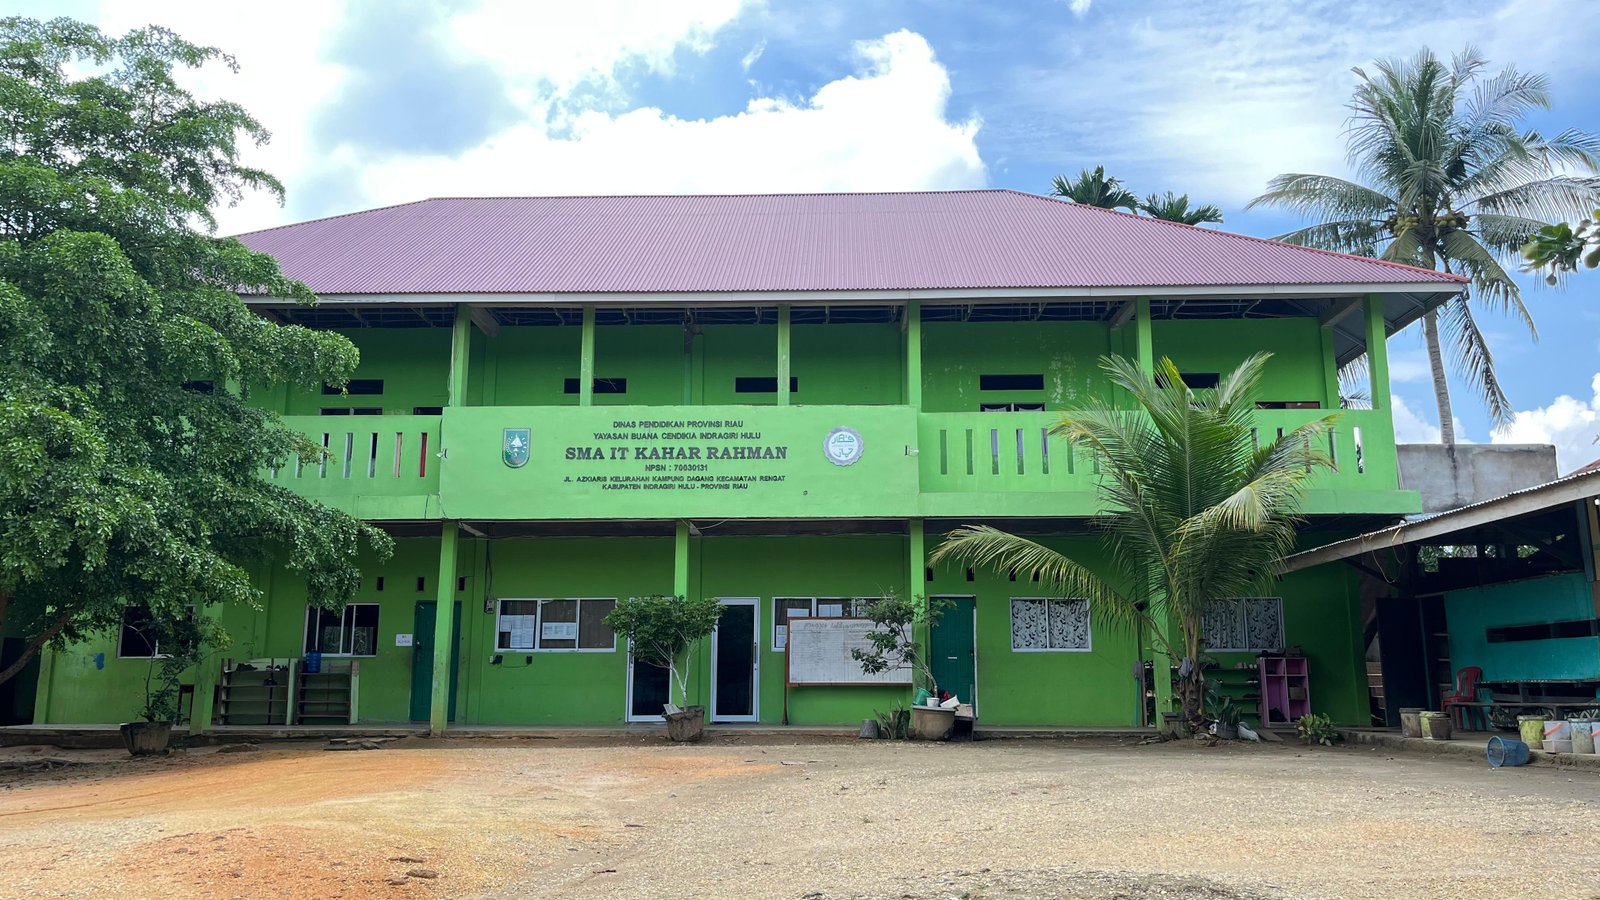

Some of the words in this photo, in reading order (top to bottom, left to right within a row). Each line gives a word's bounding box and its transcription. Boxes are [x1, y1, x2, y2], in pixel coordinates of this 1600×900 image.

[565, 447, 605, 460] SMA
[610, 447, 629, 460] IT
[635, 447, 701, 460] KAHAR
[706, 447, 788, 460] RAHMAN
